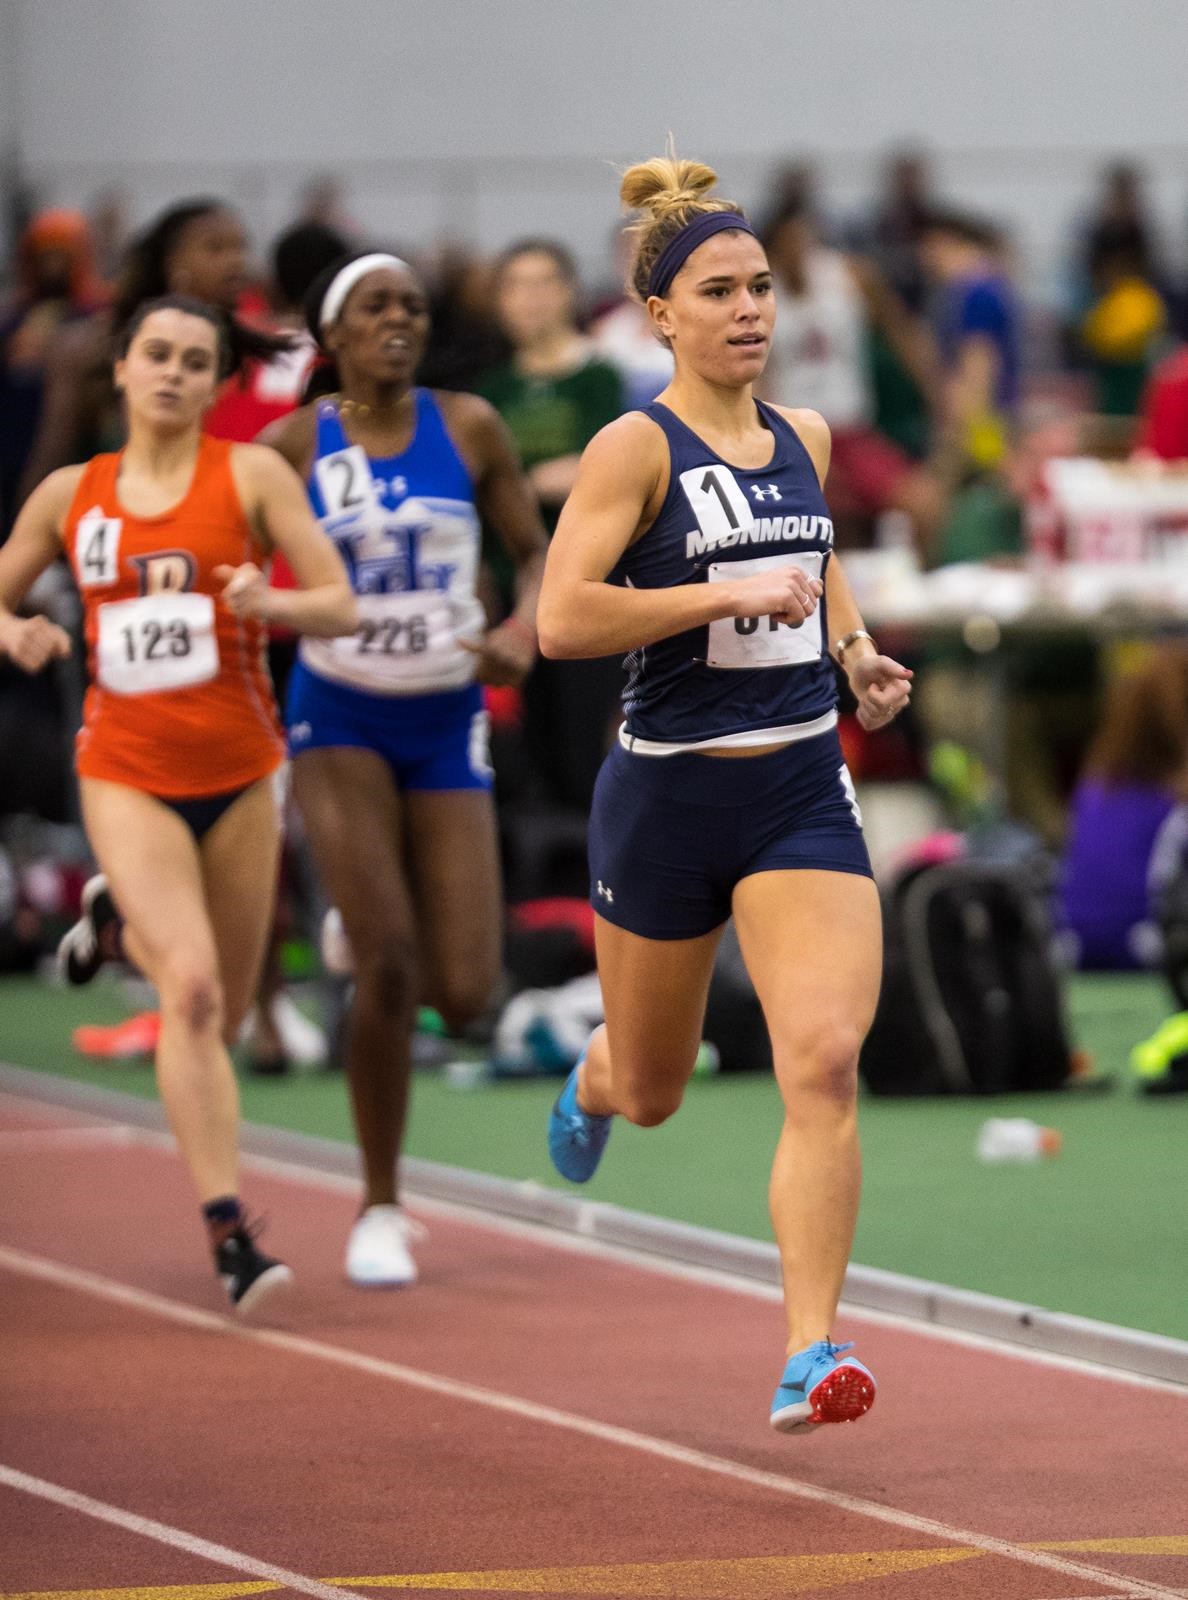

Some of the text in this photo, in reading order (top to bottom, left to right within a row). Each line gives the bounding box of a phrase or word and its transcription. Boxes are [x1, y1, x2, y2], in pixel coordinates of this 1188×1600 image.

[328, 458, 365, 508] 2
[701, 470, 740, 530] 1
[84, 523, 107, 577] 4
[121, 618, 192, 662] 123
